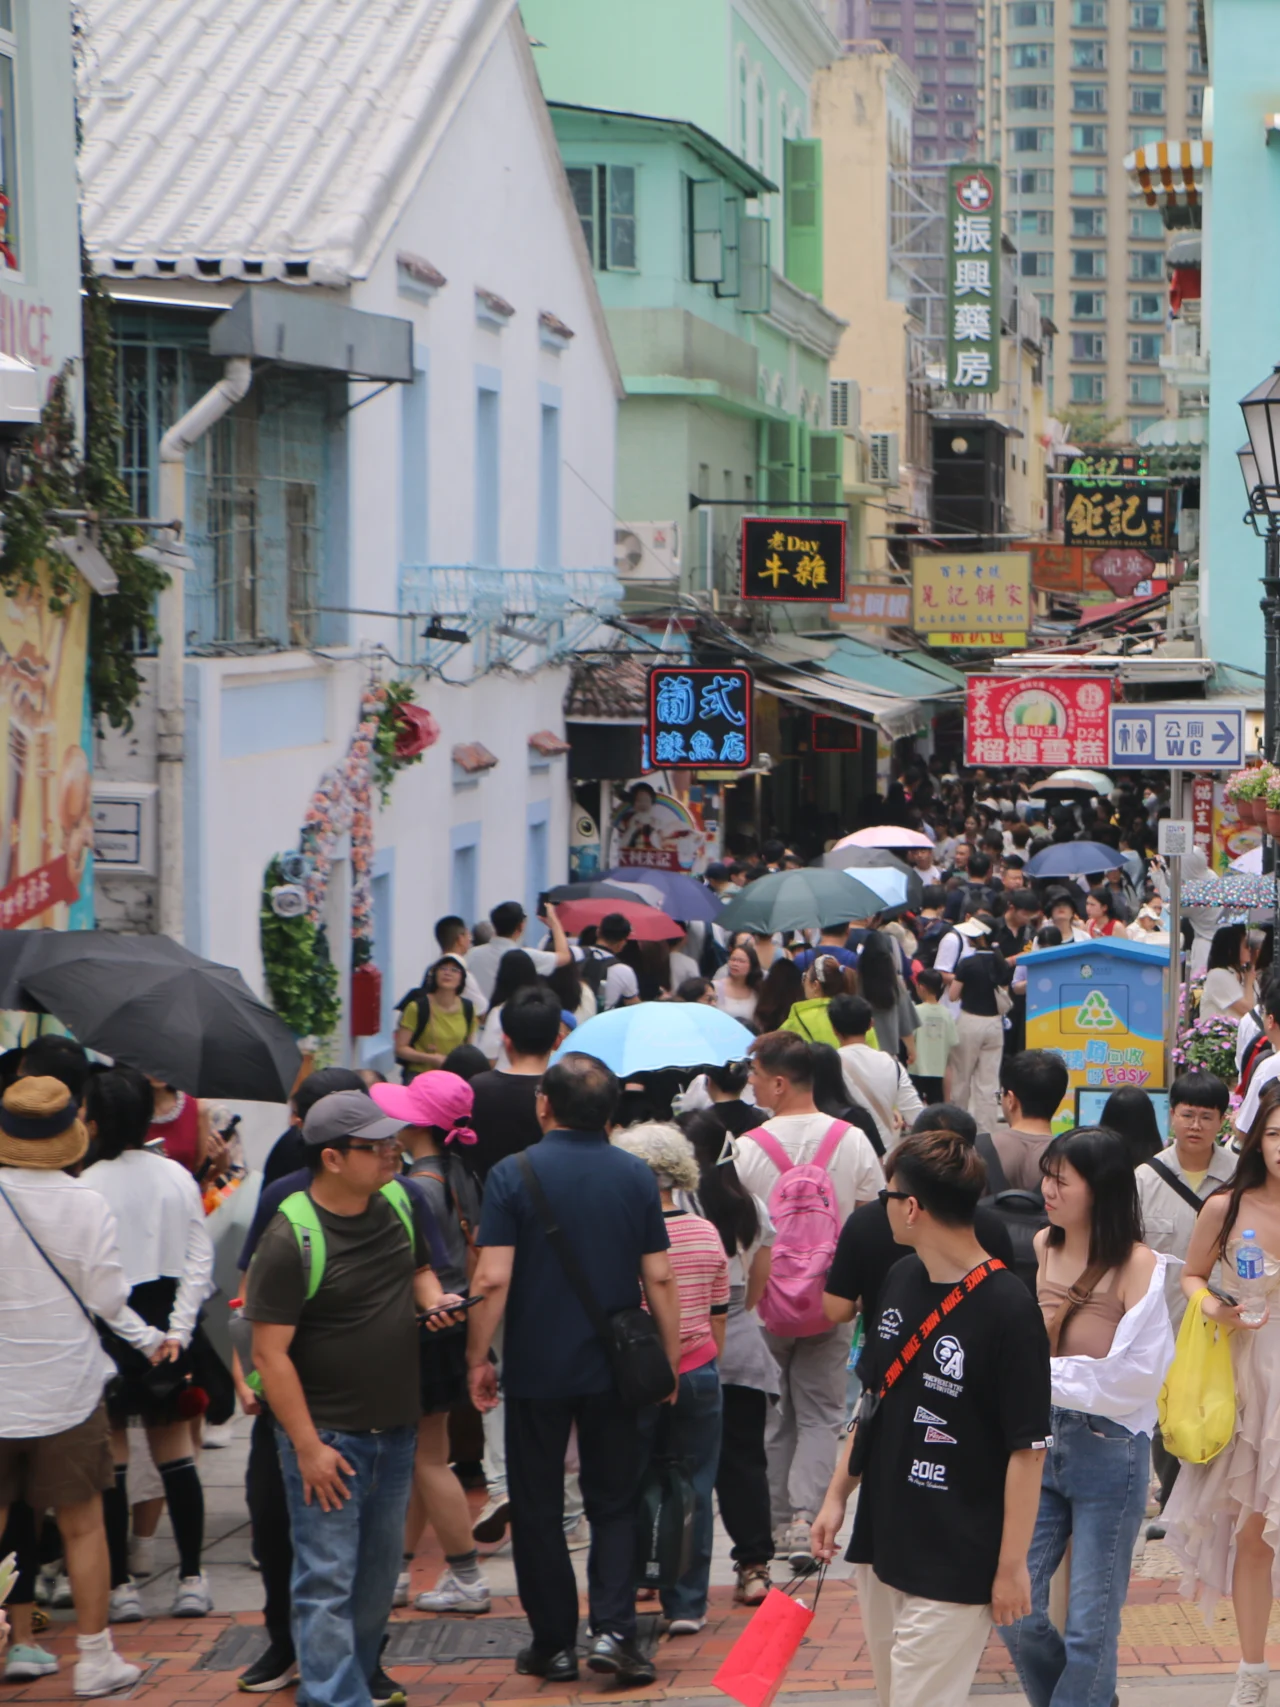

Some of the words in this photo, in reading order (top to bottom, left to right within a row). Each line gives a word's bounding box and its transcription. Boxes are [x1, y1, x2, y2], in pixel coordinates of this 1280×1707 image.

[953, 214, 992, 387] 振興藥房
[1066, 493, 1147, 537] 鉅記
[767, 530, 820, 555] 老Day
[758, 553, 828, 589] 牛雜
[656, 676, 746, 726] 葡式
[656, 730, 746, 762] 辣魚店
[1077, 728, 1104, 739] D24
[1166, 740, 1202, 756] WC
[1043, 1038, 1144, 1070] 璃樽回收
[962, 1264, 988, 1293] NIKE
[940, 1285, 964, 1316] NIKE
[919, 1309, 941, 1340] NIKE
[901, 1333, 922, 1365] NIKE
[885, 1357, 904, 1388] NIKE
[911, 1459, 946, 1482] 2012
